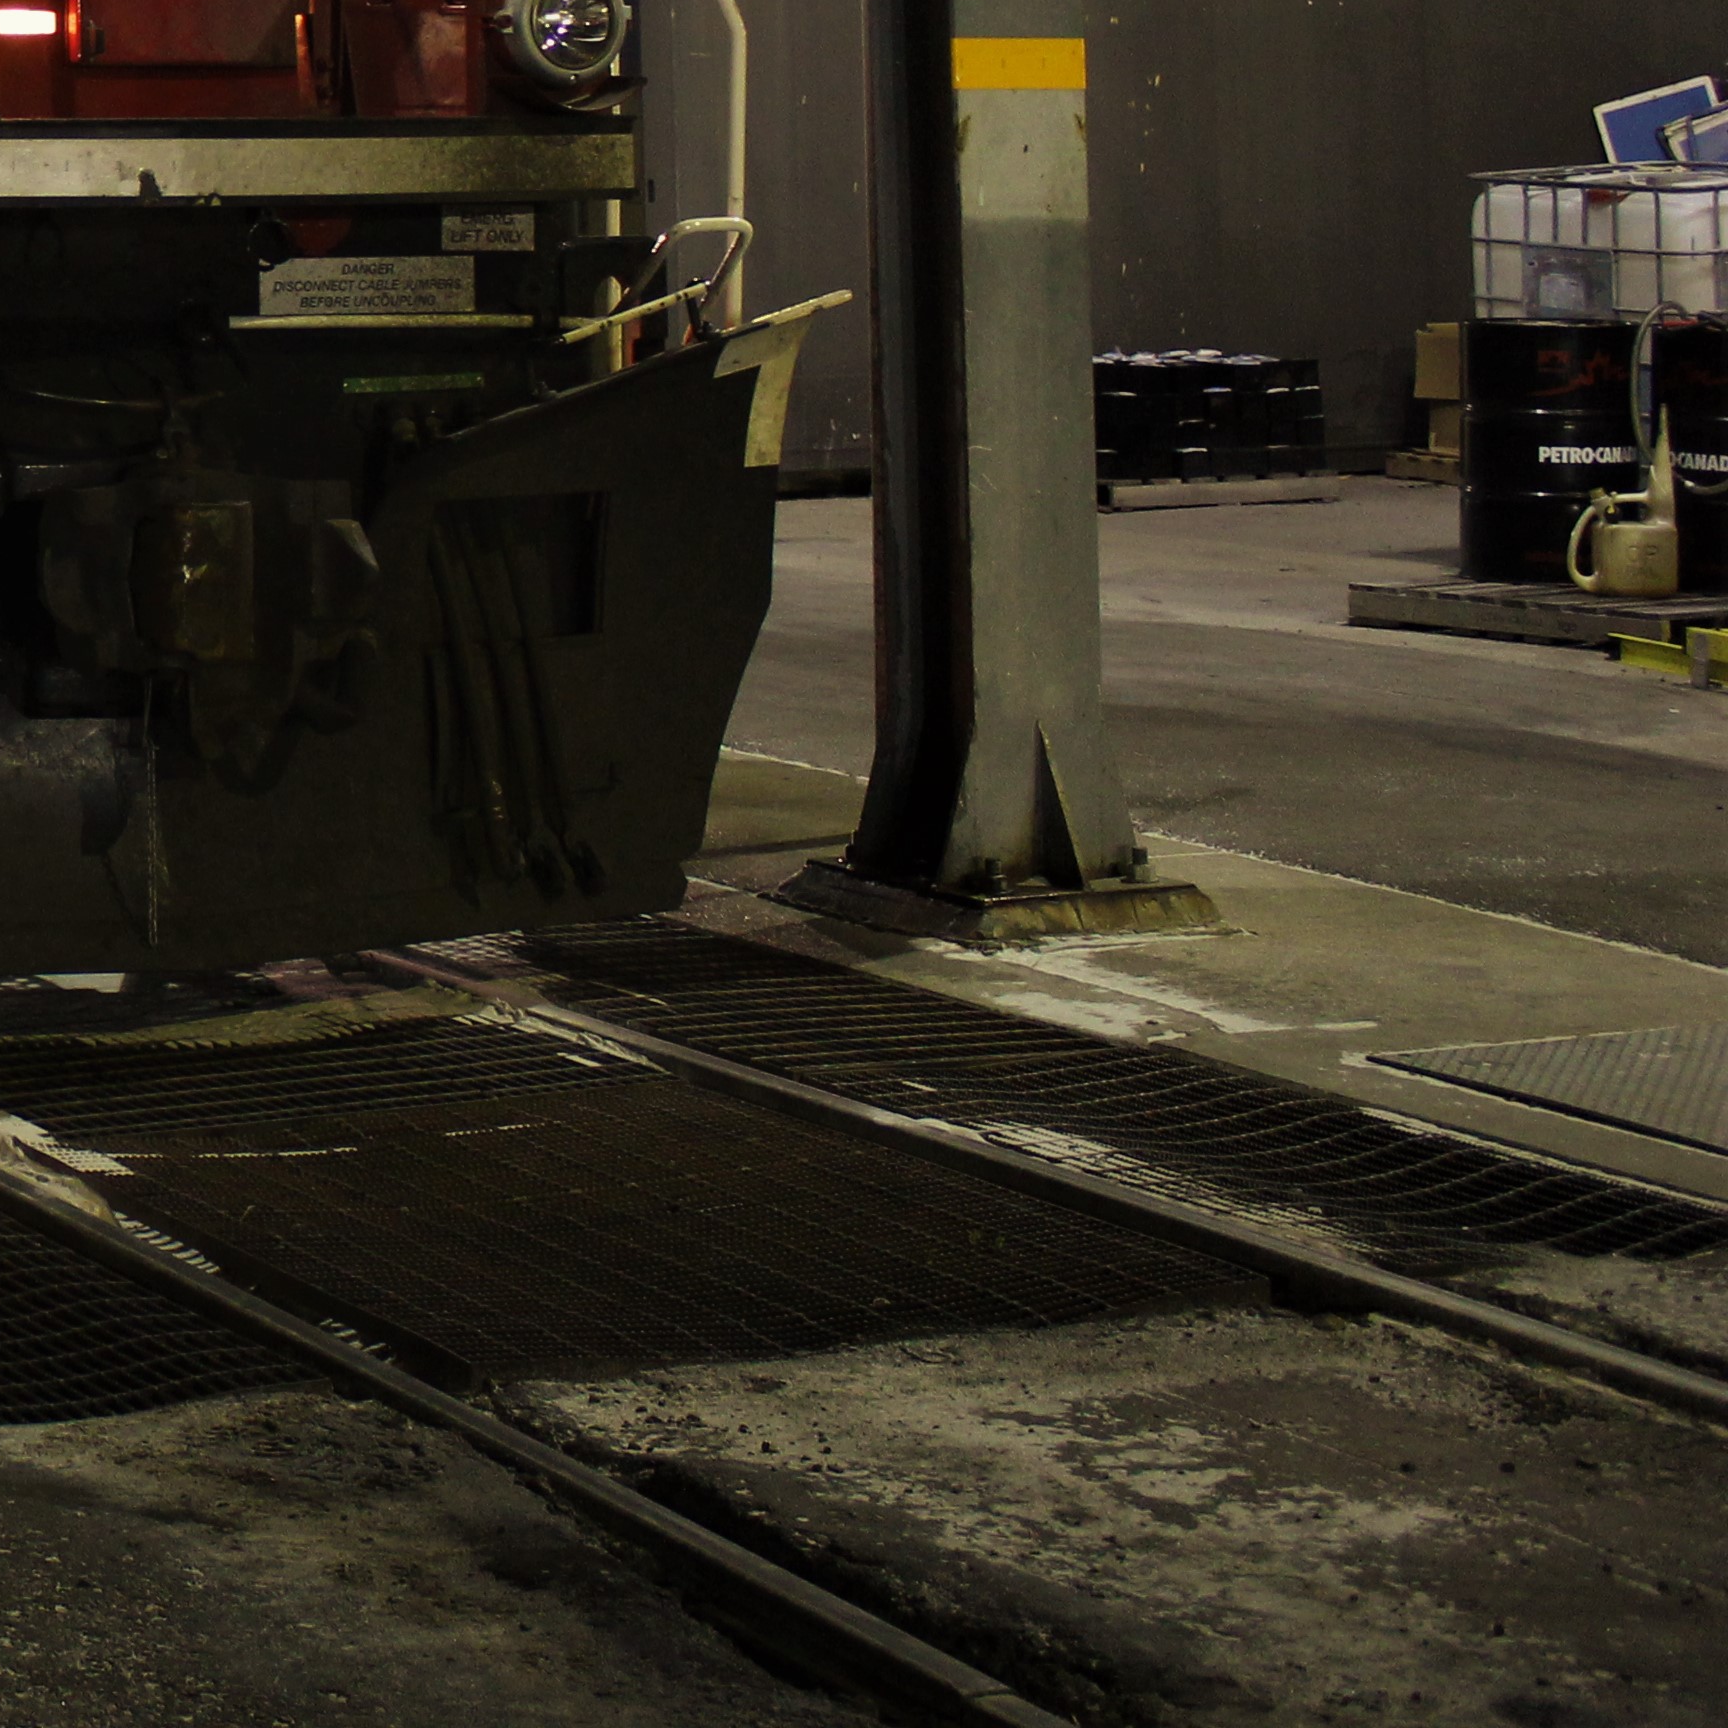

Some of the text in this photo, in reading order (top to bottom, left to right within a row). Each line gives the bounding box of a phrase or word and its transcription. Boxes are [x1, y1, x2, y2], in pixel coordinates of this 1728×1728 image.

[450, 228, 525, 244] LIFT ONLY
[341, 263, 395, 276] DANGER
[272, 277, 462, 293] DISCONNECT CABLE JUMPERS
[299, 293, 436, 309] BEFORE UNCOUPLING
